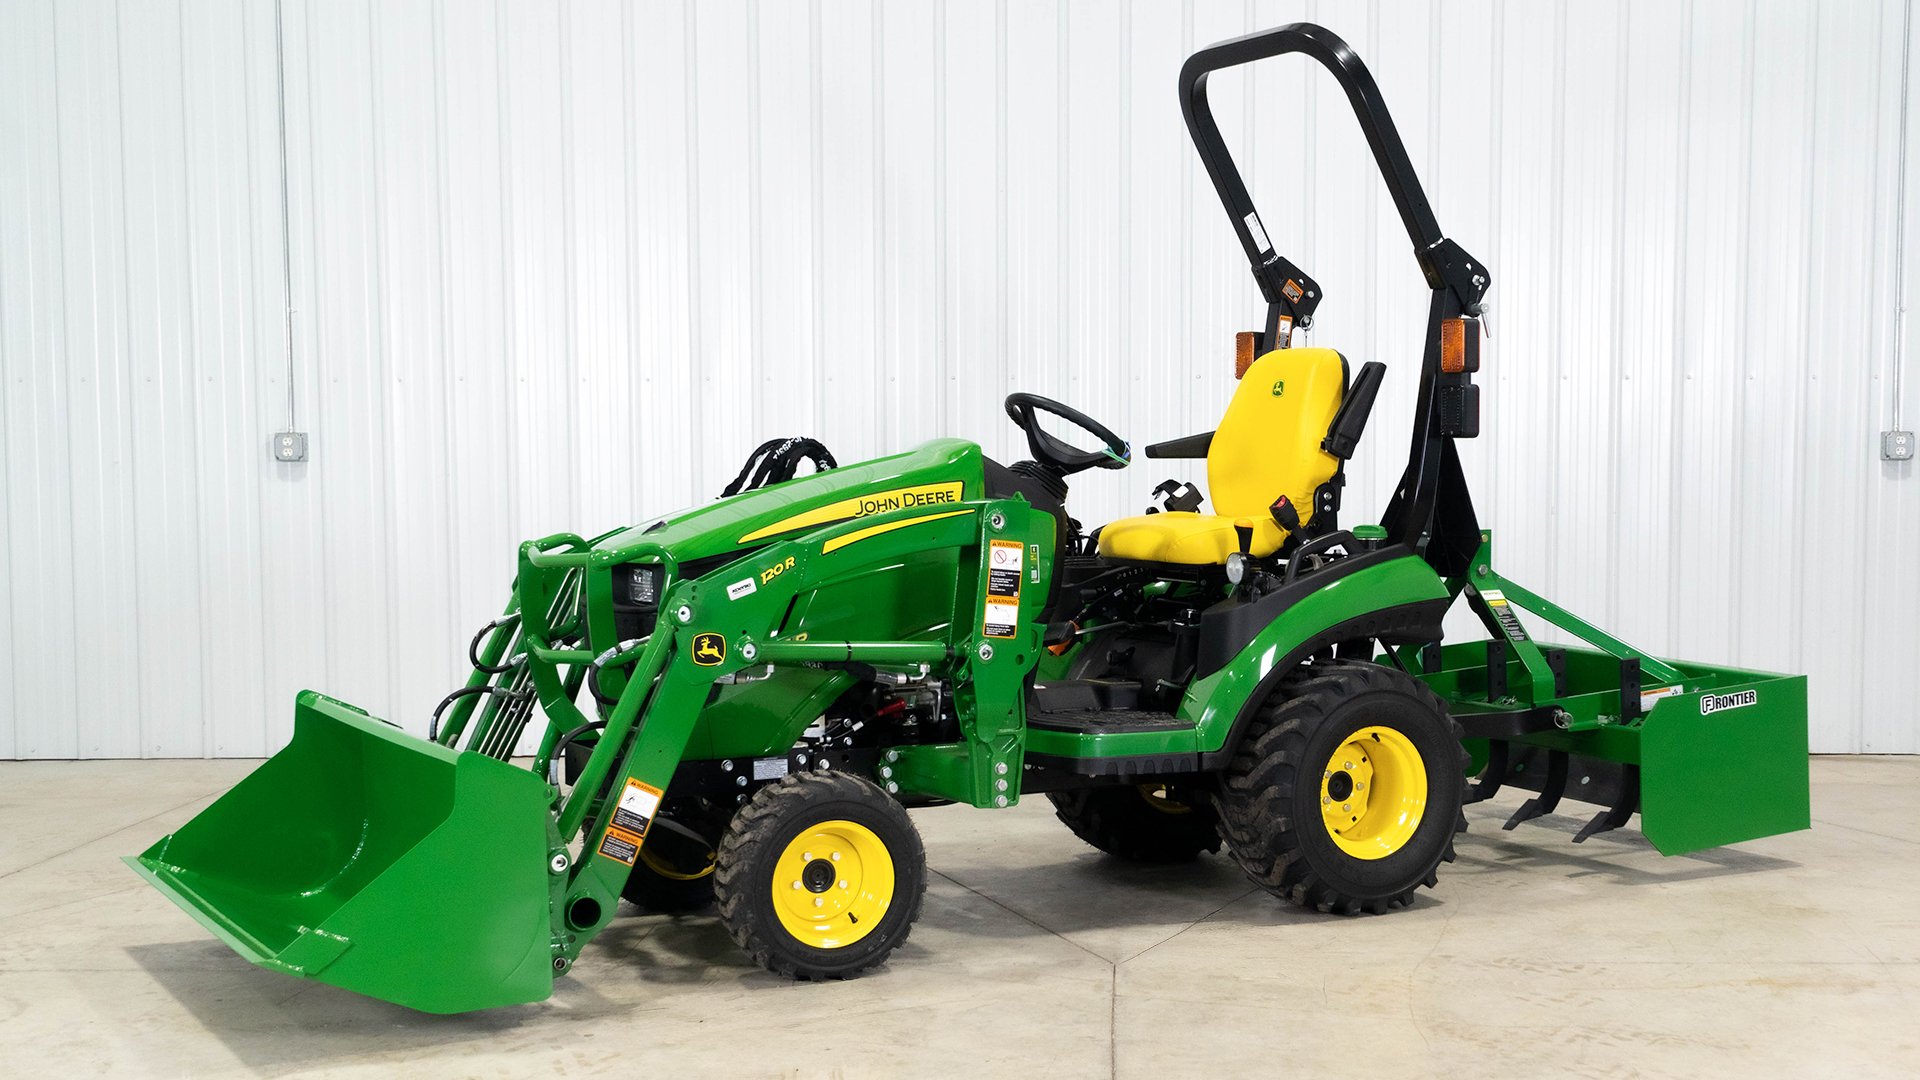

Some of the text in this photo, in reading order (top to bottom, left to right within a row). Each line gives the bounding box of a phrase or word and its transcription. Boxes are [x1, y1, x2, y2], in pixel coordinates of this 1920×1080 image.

[855, 490, 956, 515] JOHN DEERE
[997, 541, 1022, 549] WARNING
[760, 556, 796, 585] 120 R
[992, 598, 1018, 606] WARNING
[1702, 691, 1756, 713] FRONTIER
[636, 783, 659, 795] WARNING
[616, 831, 638, 844] WARNING
